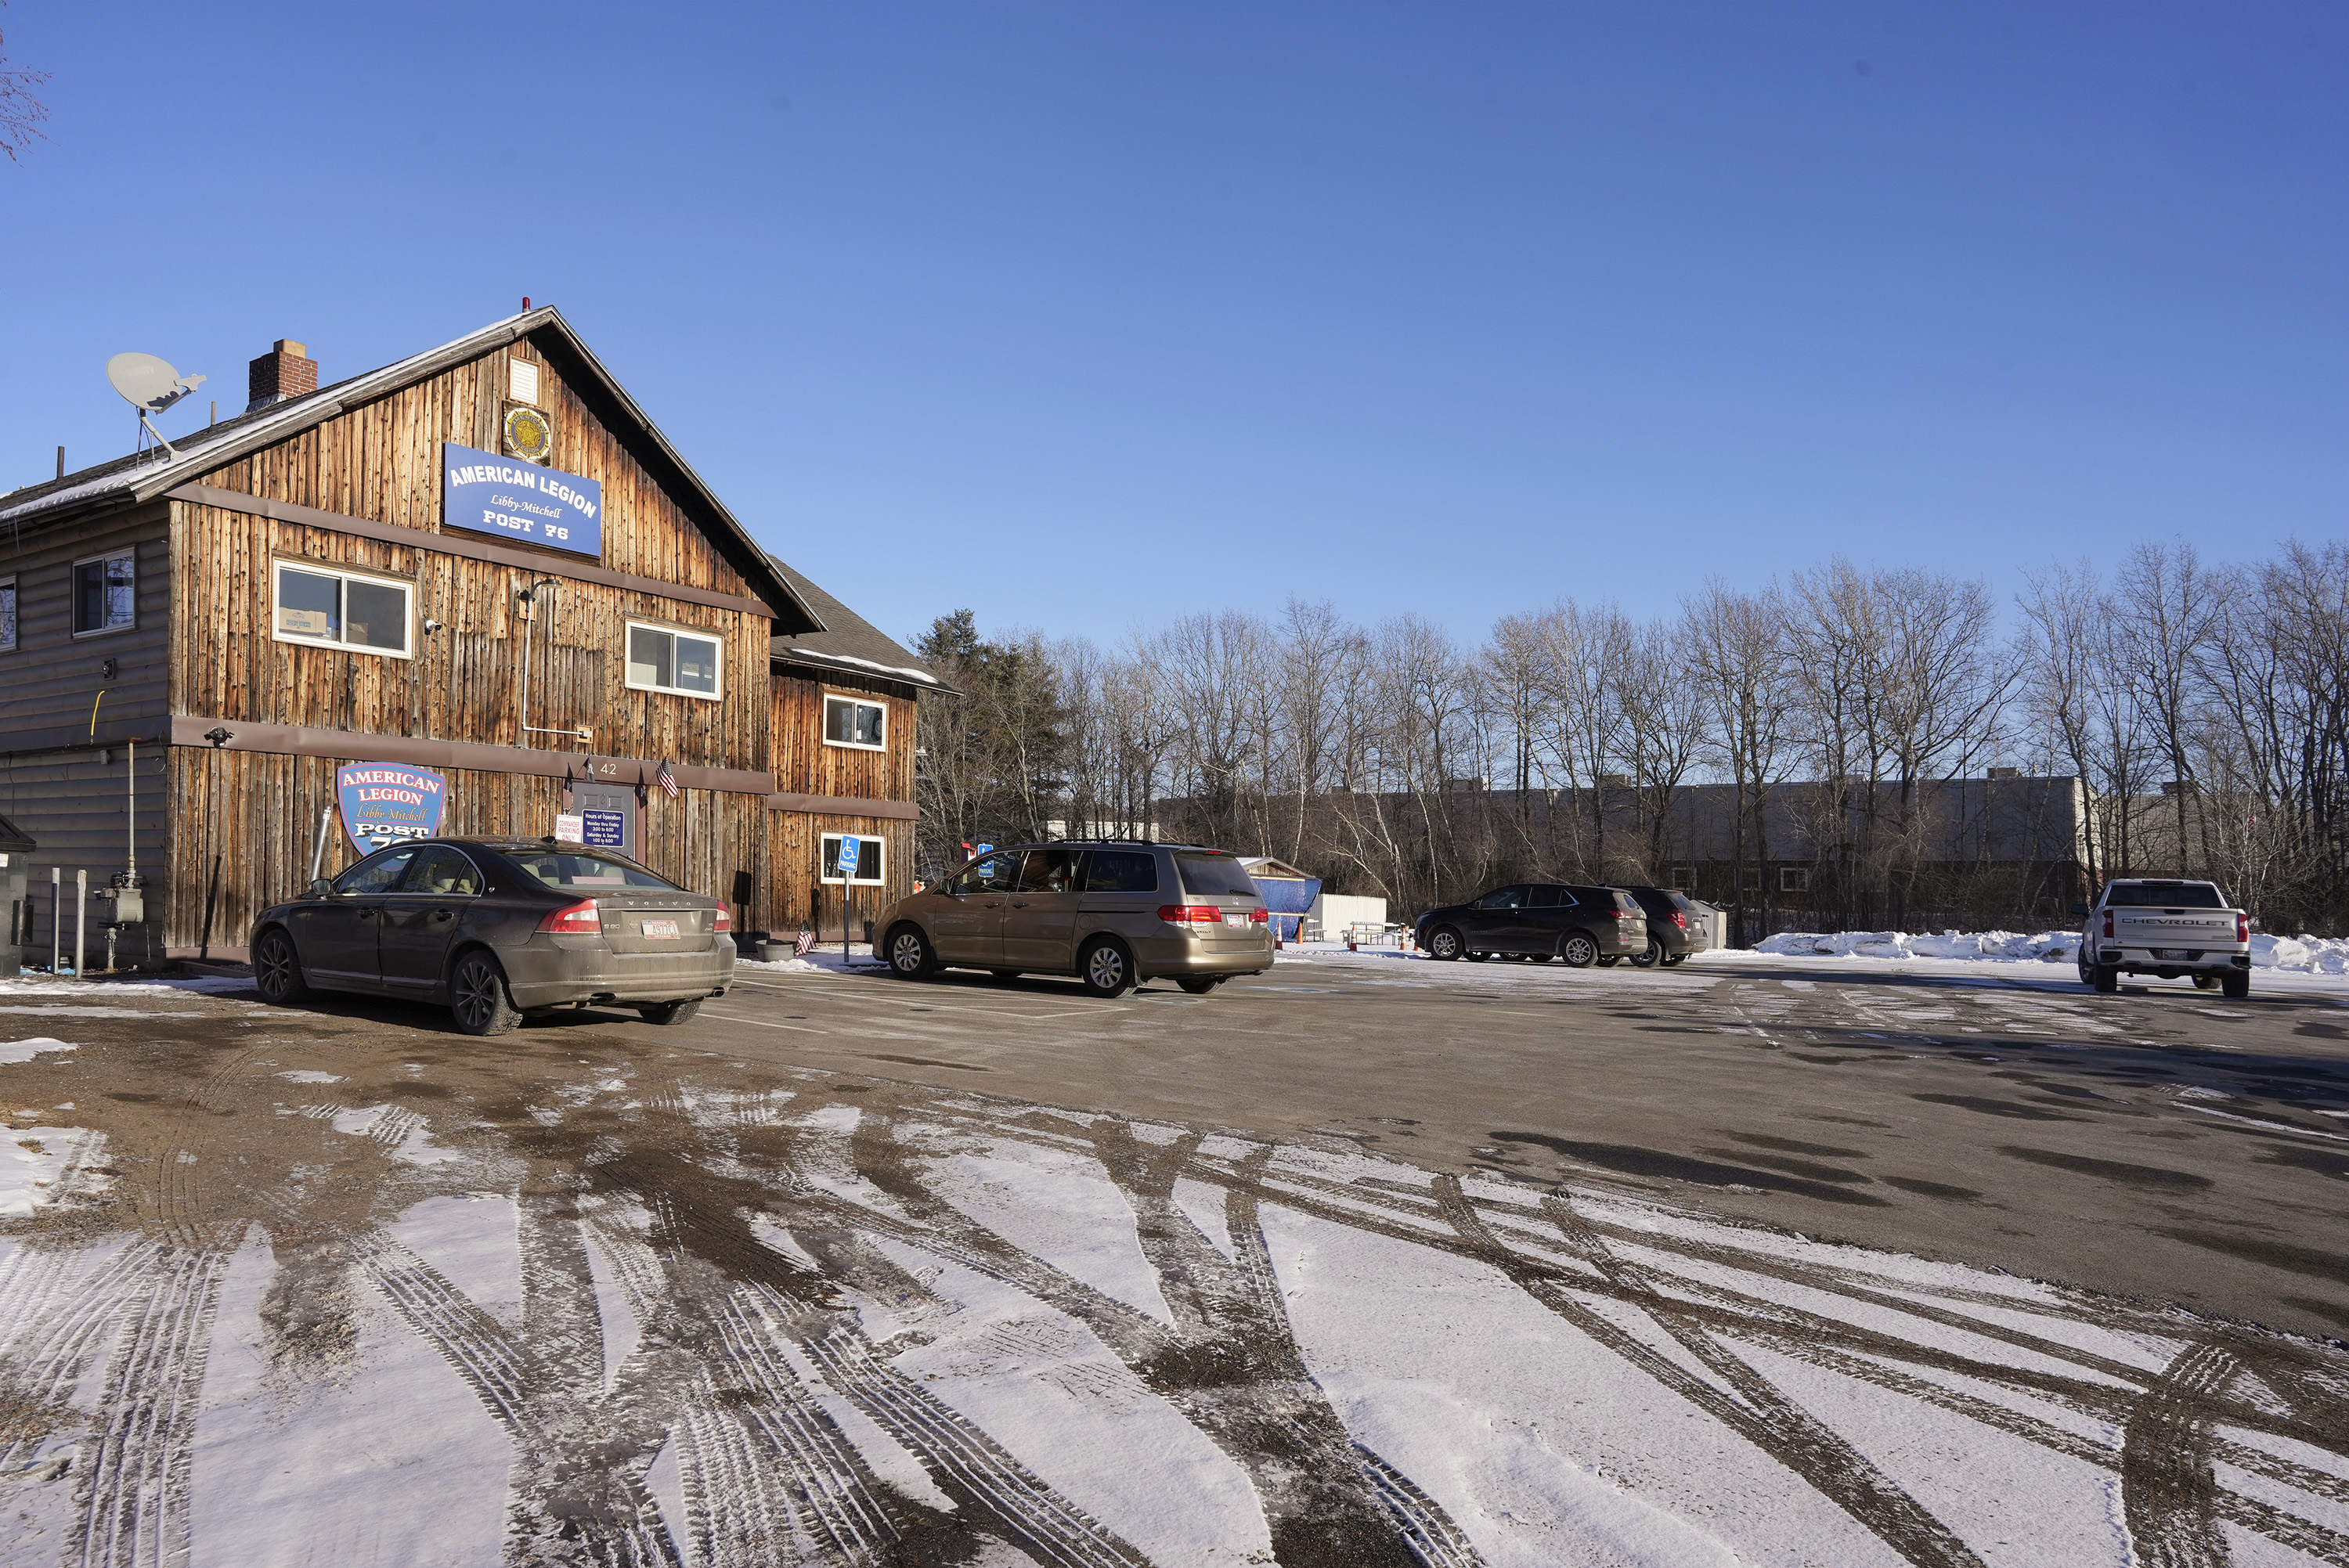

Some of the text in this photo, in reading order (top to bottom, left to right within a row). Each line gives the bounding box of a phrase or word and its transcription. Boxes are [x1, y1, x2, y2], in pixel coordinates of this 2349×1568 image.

[513, 415, 544, 433] AMERICAN
[517, 442, 539, 453] LEGION
[450, 465, 597, 518] AMERICAN LEGION
[490, 494, 563, 519] Libby-Mitchell
[482, 510, 568, 540] POST 76
[601, 763, 616, 775] 42
[343, 770, 440, 795] AMERICAN
[357, 788, 424, 806] LEGION
[356, 802, 429, 824] Libby-Mitchell
[355, 823, 429, 839] POST
[840, 860, 856, 869] PARKING
